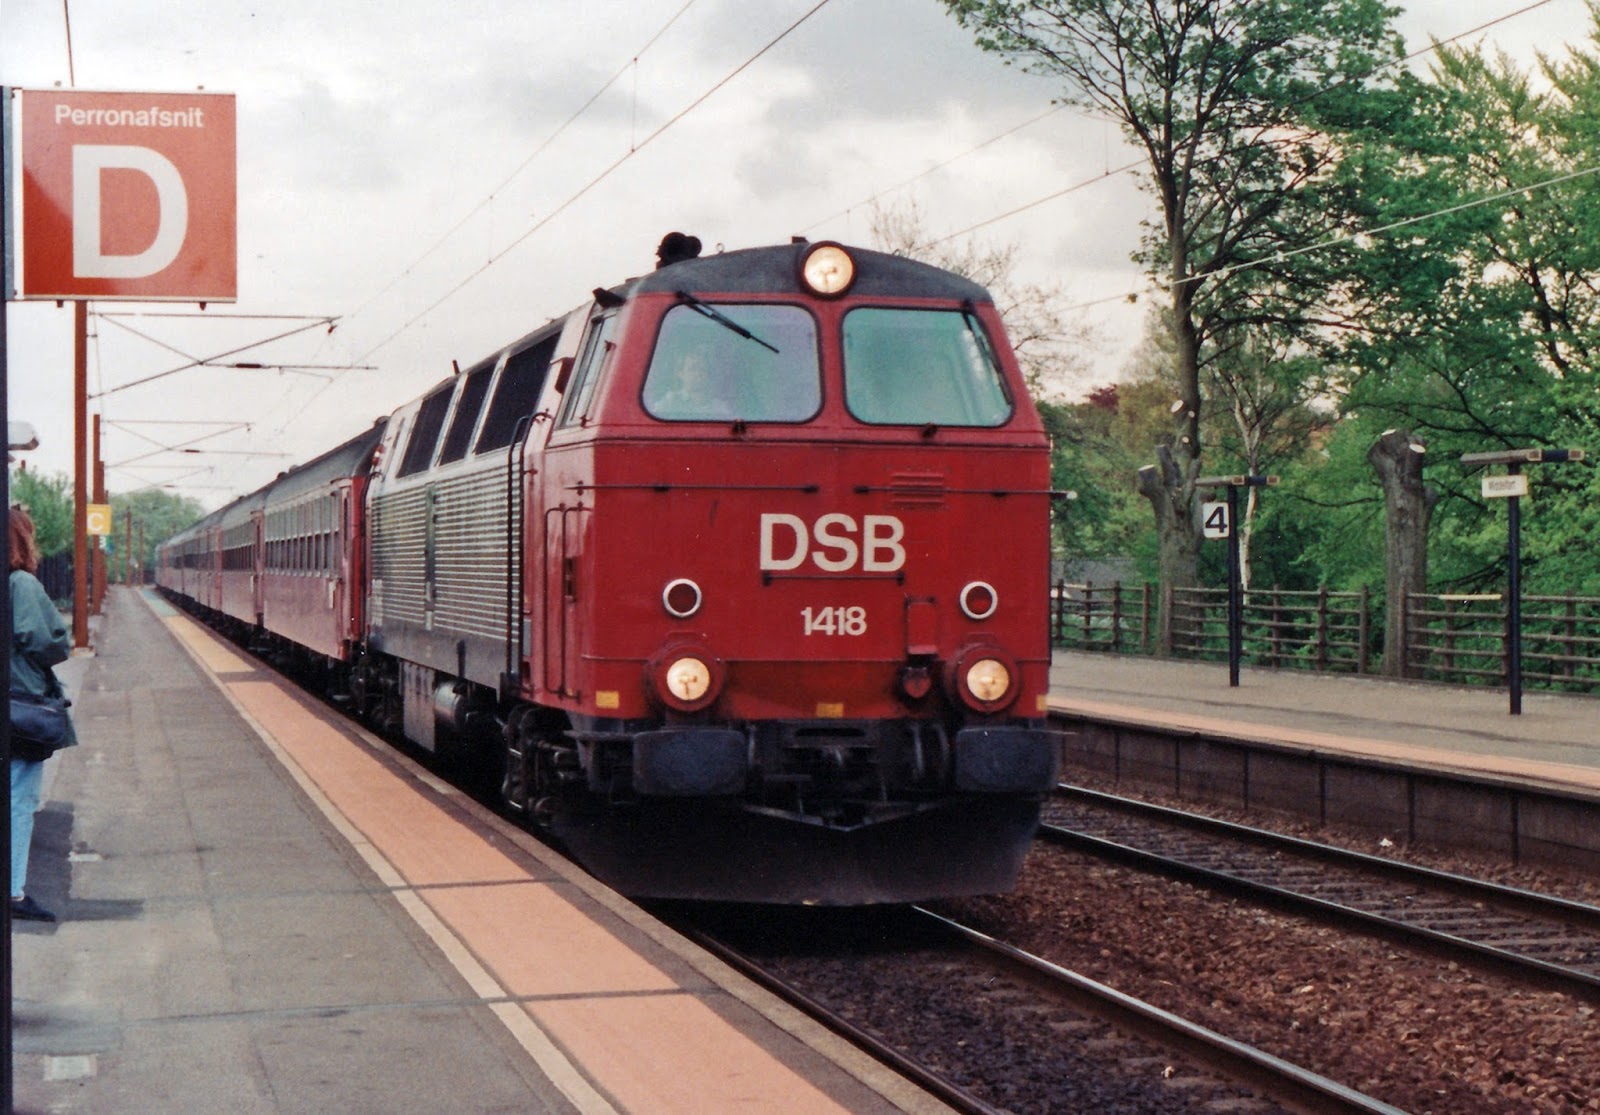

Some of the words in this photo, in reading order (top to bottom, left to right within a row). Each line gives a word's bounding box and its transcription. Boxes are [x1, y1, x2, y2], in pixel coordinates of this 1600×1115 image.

[55, 104, 204, 128] Perronafsnit
[72, 144, 189, 278] D
[87, 512, 104, 532] C
[1205, 506, 1228, 533] 4
[760, 513, 906, 572] DSB
[801, 606, 867, 636] 1418
